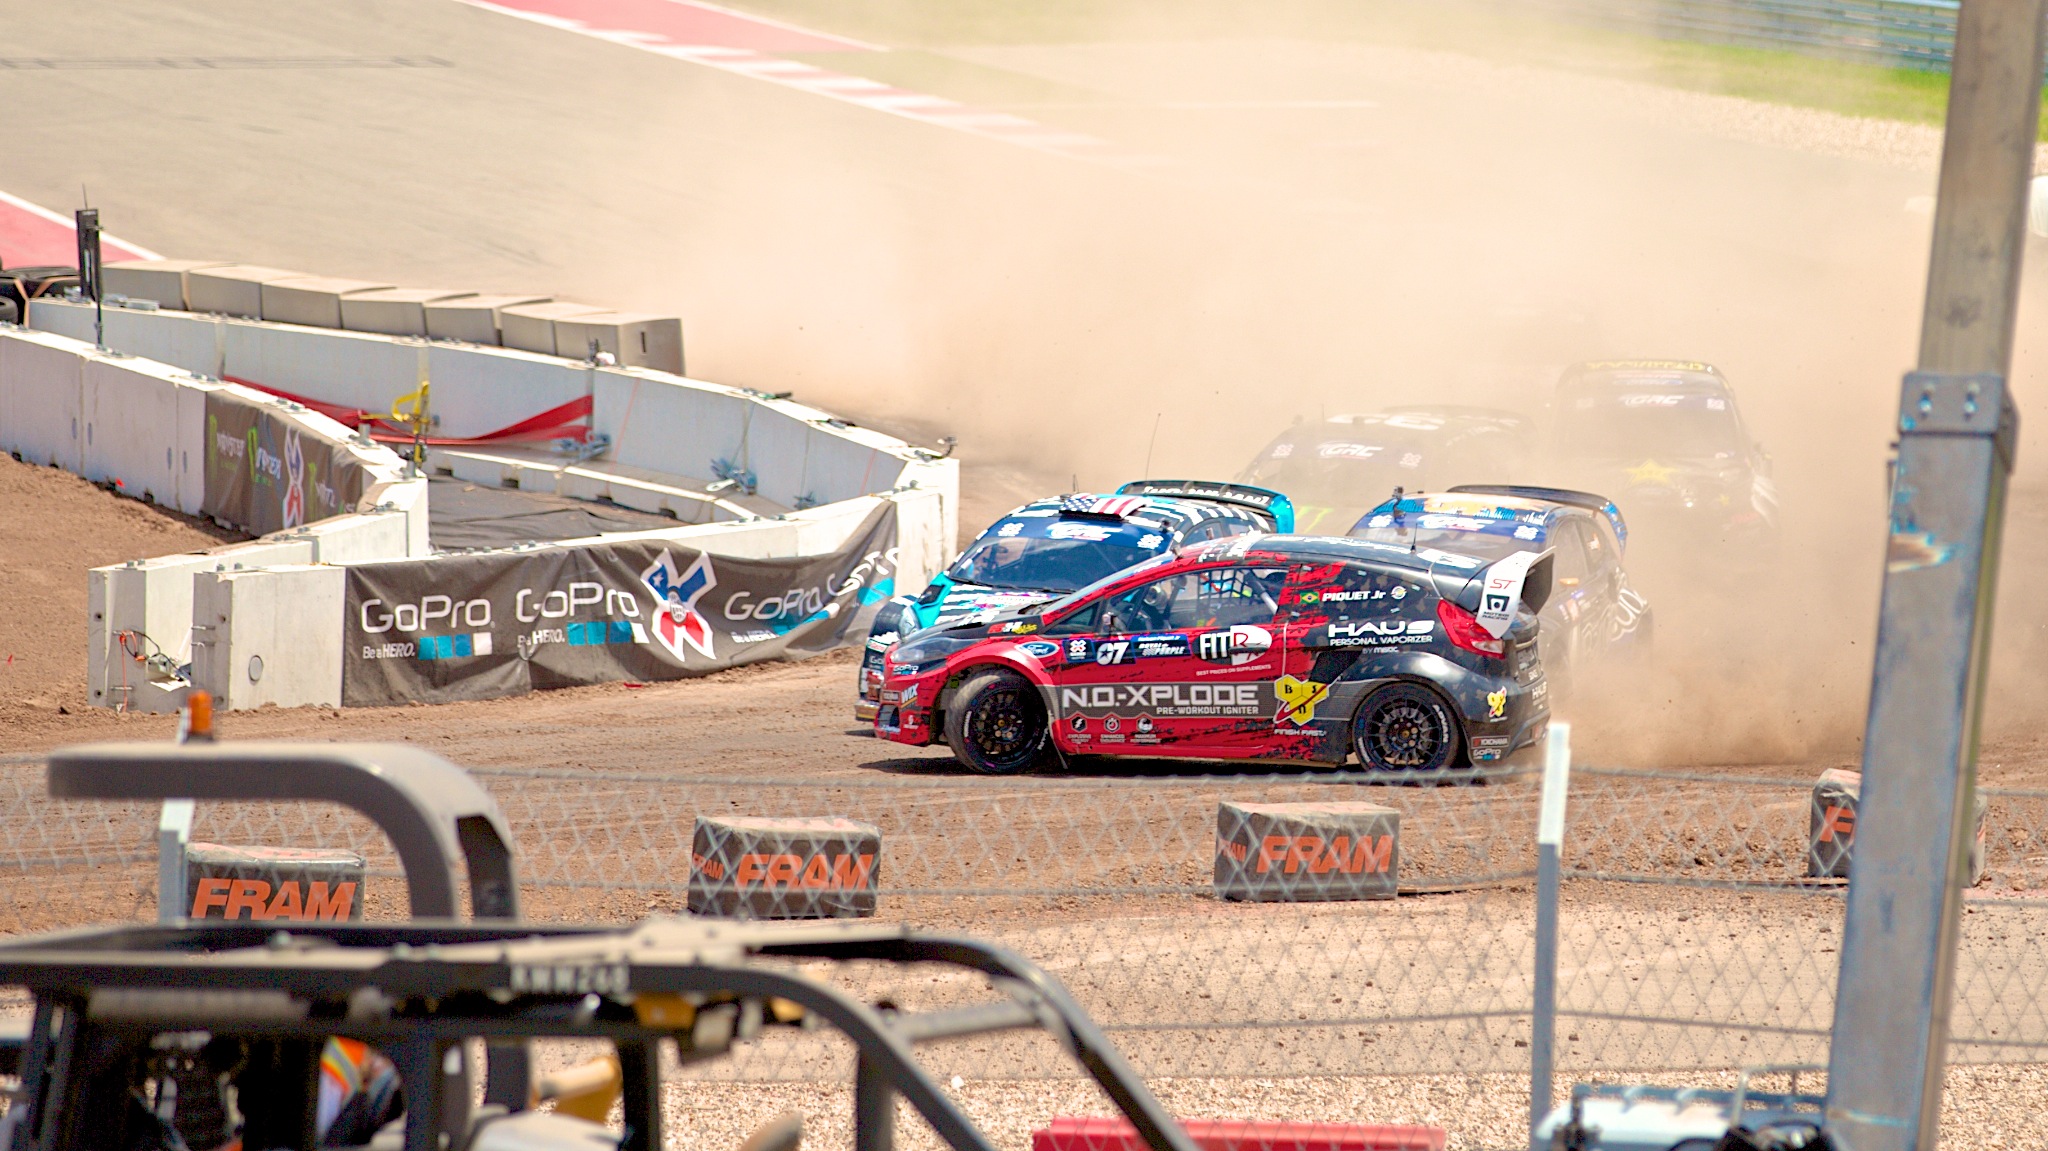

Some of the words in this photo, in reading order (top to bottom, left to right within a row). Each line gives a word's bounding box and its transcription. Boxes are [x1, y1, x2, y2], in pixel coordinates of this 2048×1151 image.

[1322, 442, 1384, 458] GRC
[1489, 578, 1518, 589] ST
[516, 582, 640, 622] GoPro
[724, 587, 823, 620] GoPro
[1323, 590, 1370, 601] PIQUET
[1371, 591, 1387, 600] Jr
[361, 595, 492, 633] GoPro
[1328, 621, 1435, 637] HAUS
[363, 646, 376, 658] Be
[383, 643, 416, 658] HERO.
[1330, 637, 1378, 647] PERSONAL
[1381, 635, 1433, 645] VAPORIZER
[1097, 642, 1130, 665] 07
[901, 683, 919, 704] WIX
[1156, 706, 1221, 715] PRE-WORKOUT
[1223, 706, 1259, 714] IGNITER
[1432, 704, 1449, 743] ADVAN
[1473, 748, 1502, 757] GoPro
[1256, 835, 1394, 874] FRAM
[734, 854, 874, 892] FRAM
[191, 877, 357, 923] FRAM
